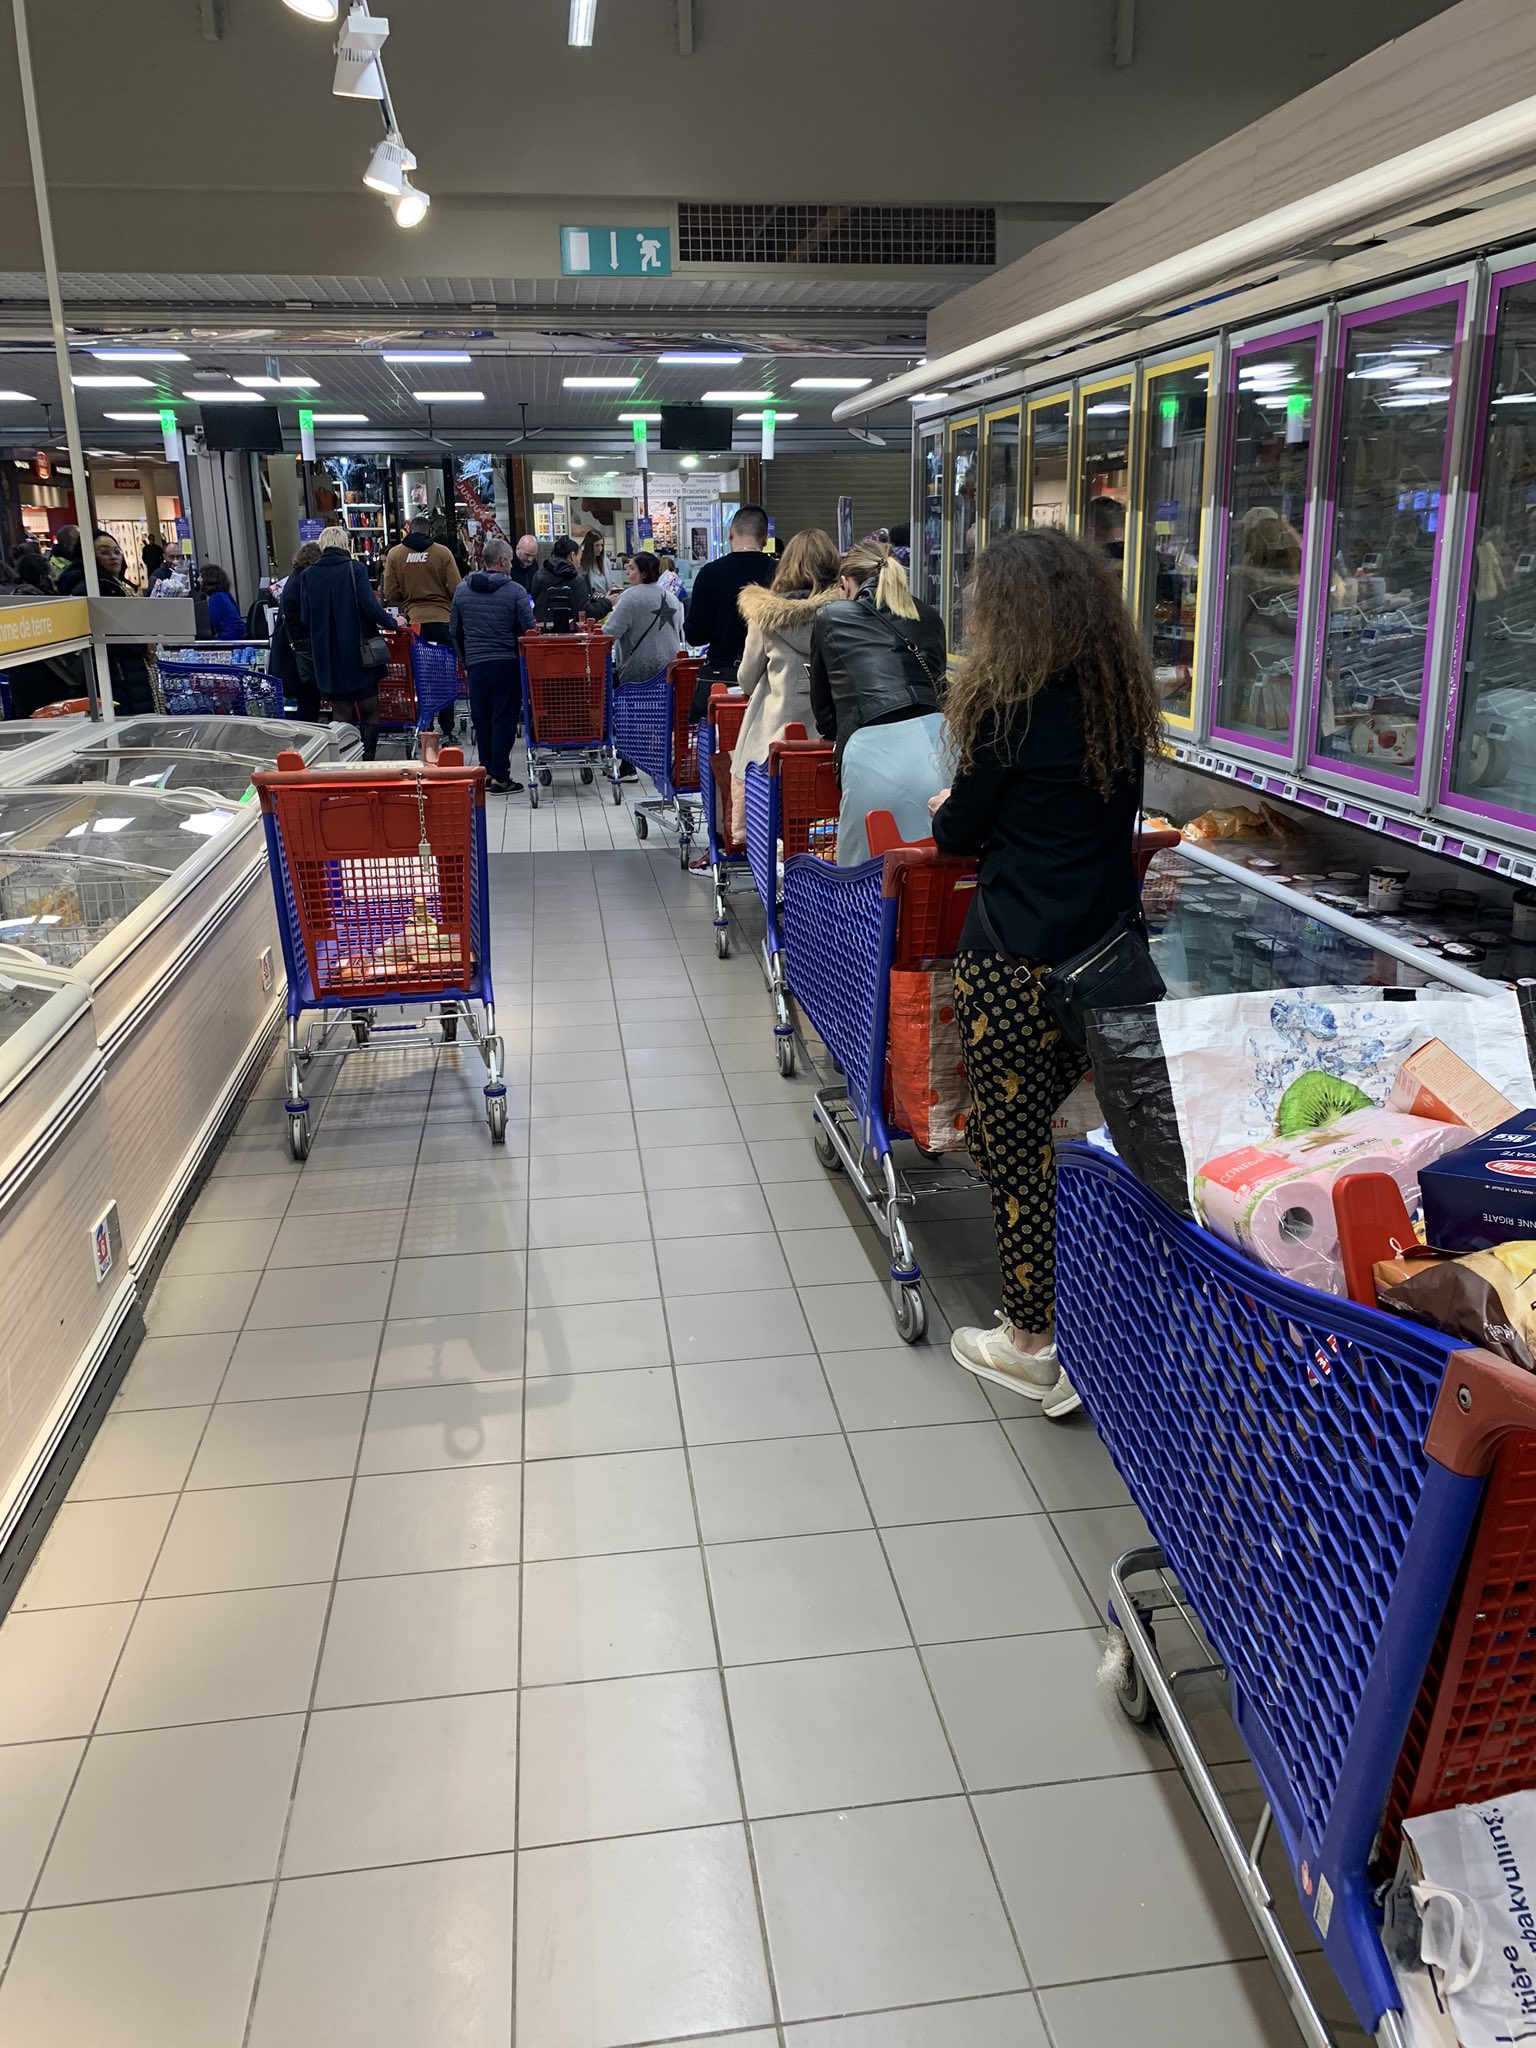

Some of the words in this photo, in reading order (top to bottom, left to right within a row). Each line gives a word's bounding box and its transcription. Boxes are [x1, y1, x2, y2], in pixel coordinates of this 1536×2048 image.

[632, 487, 671, 497] Chgement
[405, 552, 429, 563] NIKE
[20, 615, 31, 638] de
[31, 615, 52, 637] terre
[1050, 1117, 1069, 1128] a.fr
[1482, 1212, 1514, 1226] RIGATE
[1516, 1218, 1536, 1229] NNE
